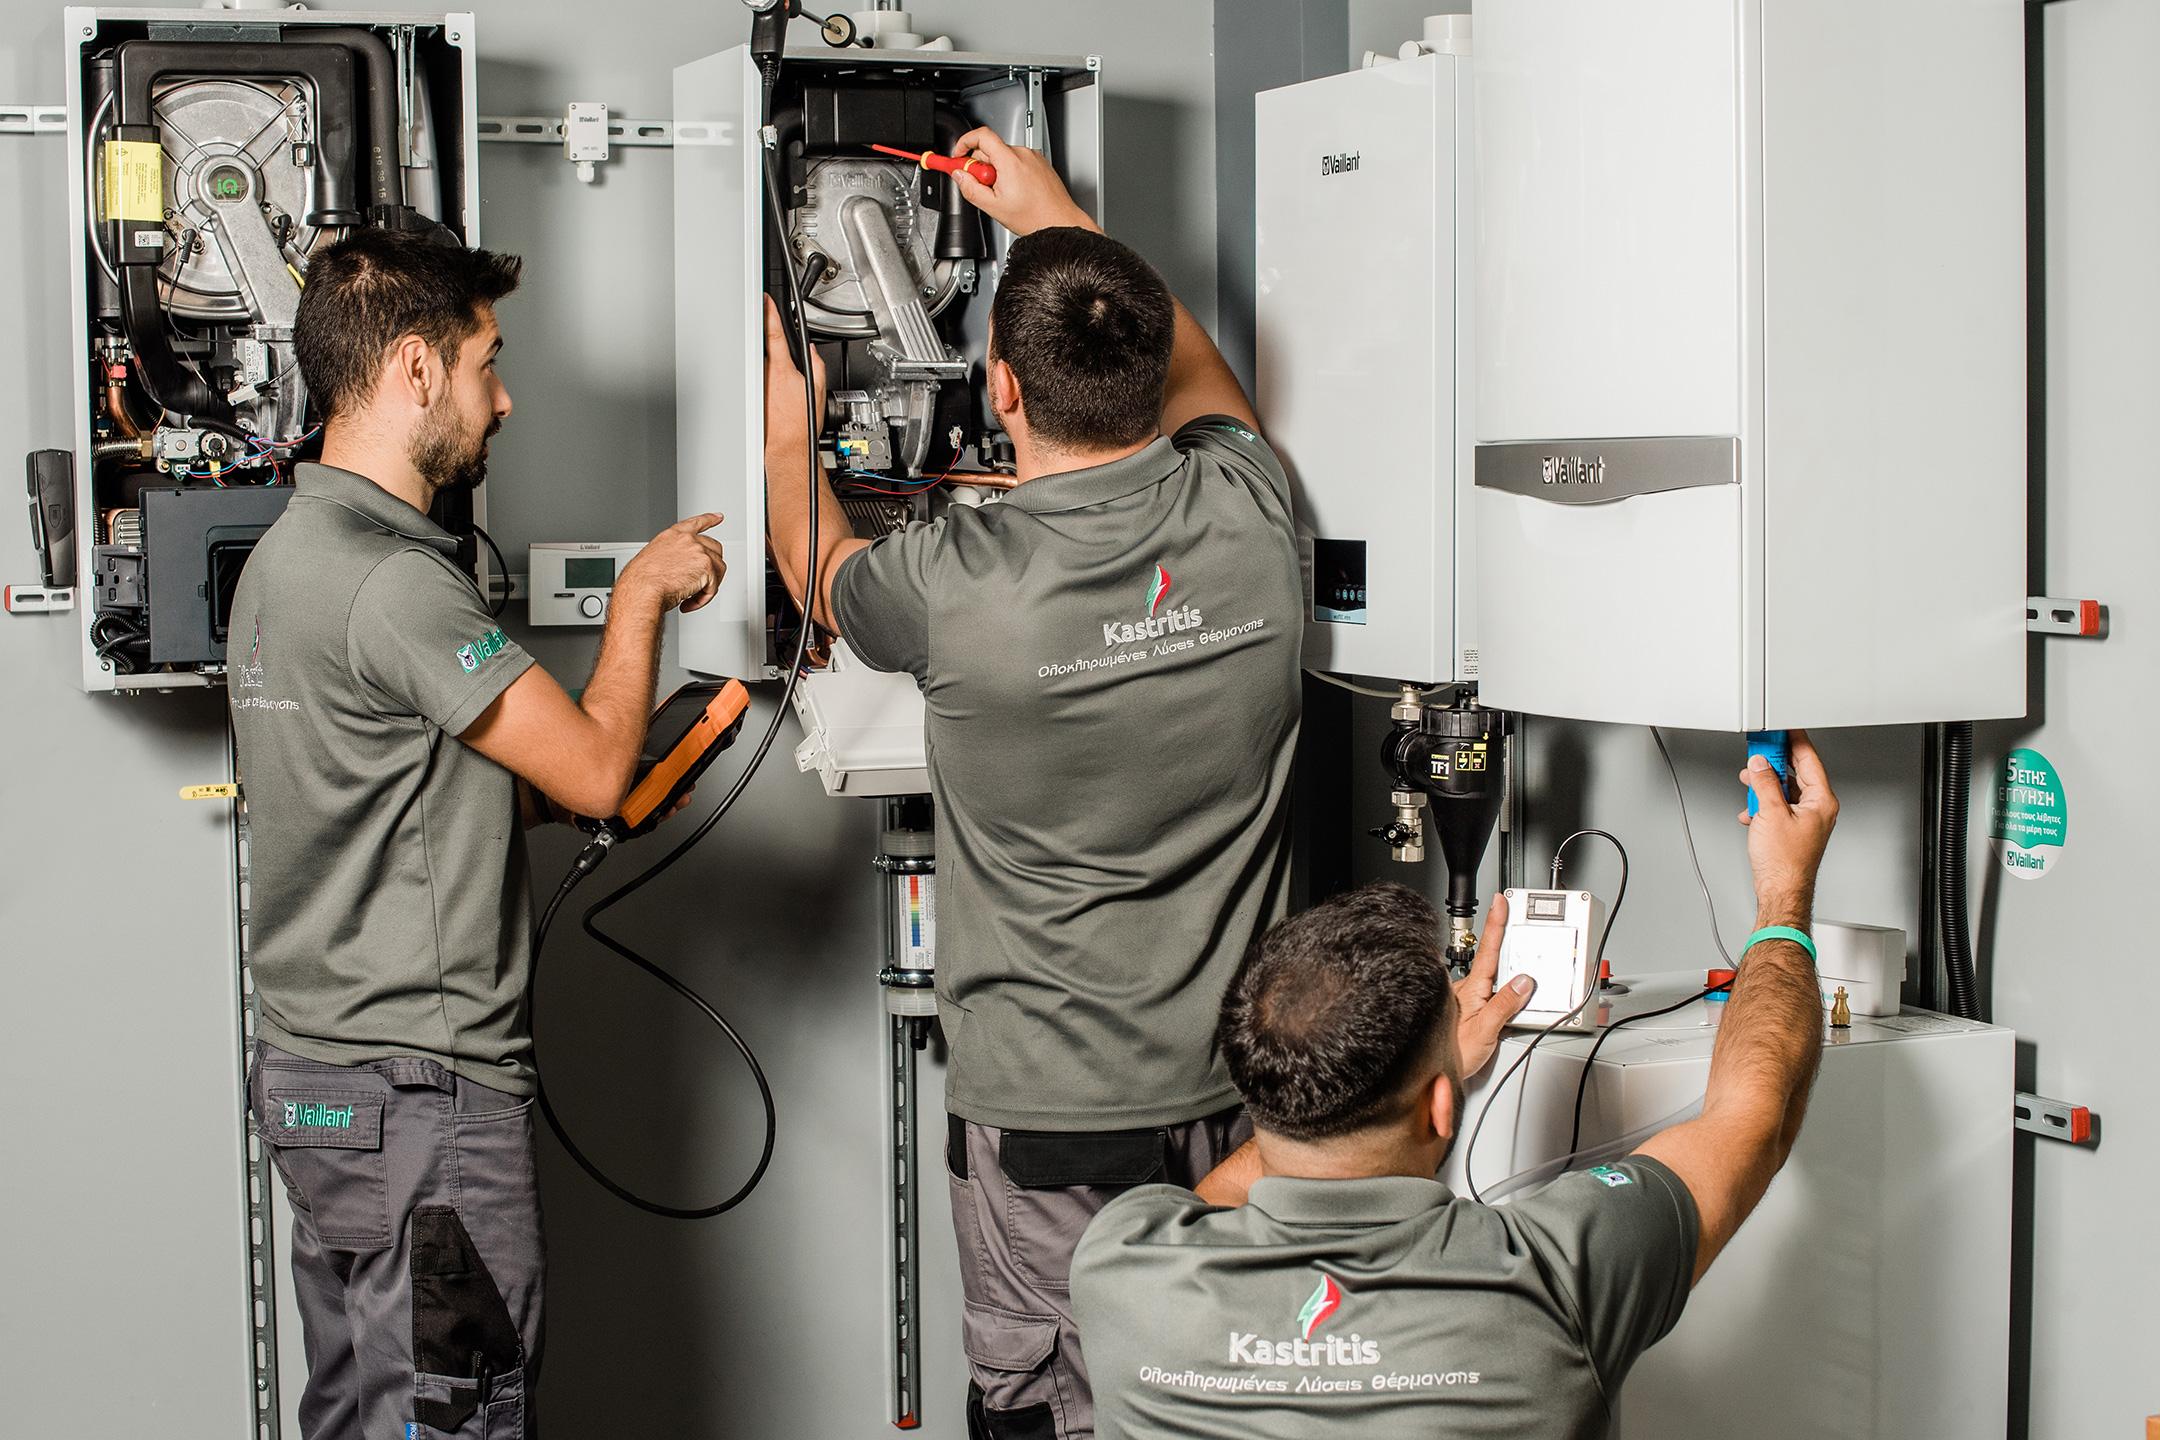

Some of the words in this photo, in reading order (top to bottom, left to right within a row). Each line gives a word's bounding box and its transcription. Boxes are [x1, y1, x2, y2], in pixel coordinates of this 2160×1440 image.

[1329, 150, 1361, 175] Vaillant
[1553, 455, 1606, 484] Vaillant
[1102, 605, 1203, 647] Kastritis
[1038, 650, 1148, 678] Ολοκληρωμένες
[1152, 640, 1195, 657] Λύσεις
[1199, 618, 1264, 645] Θέρμανσης
[1431, 760, 1450, 775] TF1
[1998, 786, 2055, 808] ΕΓΓΥΗΣΗ
[2005, 821, 2017, 831] όλα
[2018, 824, 2026, 832] τα
[2026, 823, 2042, 836] μέρη
[2043, 827, 2058, 837] τους
[2021, 812, 2036, 822] τους
[2036, 812, 2061, 825] λέβητες
[2014, 851, 2045, 870] Vaillant
[297, 1103, 354, 1129] Vaillant
[1229, 1331, 1381, 1367] Kastritis
[1139, 1366, 1289, 1394] Ολοκληρωμένες
[1295, 1375, 1363, 1393] Λύσεις
[1371, 1371, 1481, 1391] Θέρμανσης
